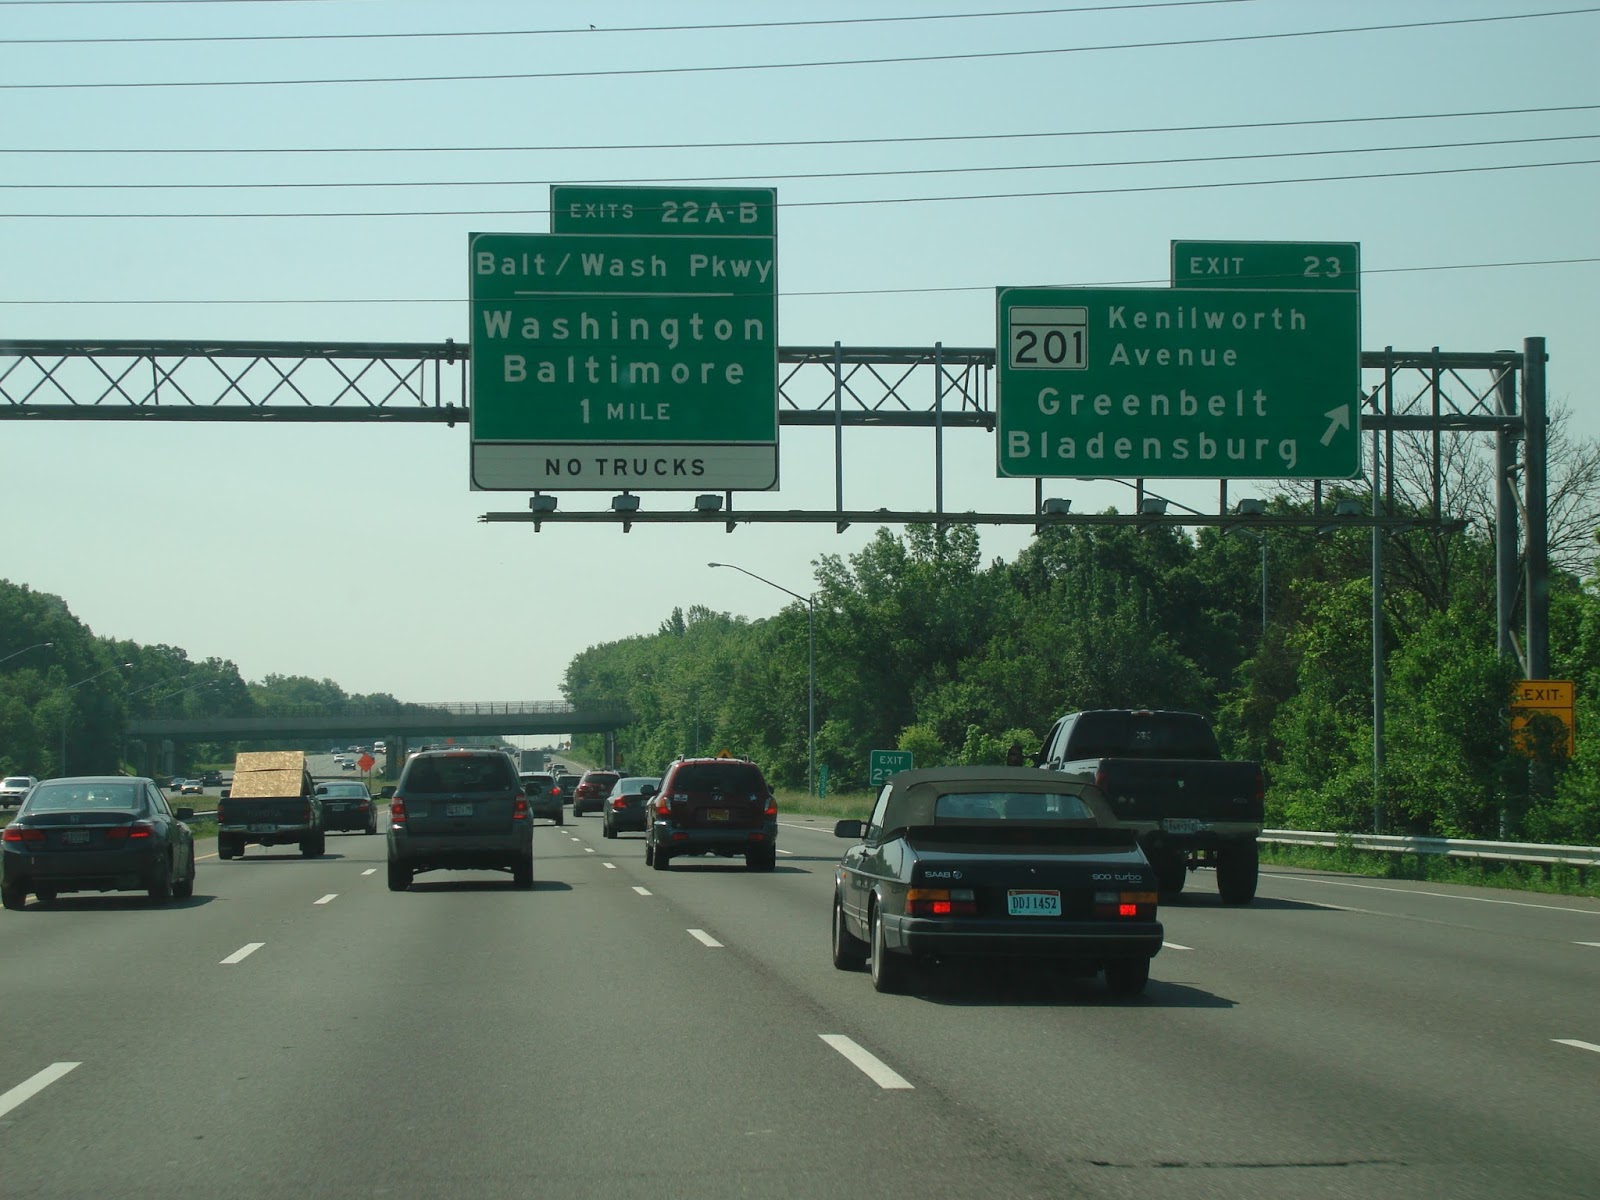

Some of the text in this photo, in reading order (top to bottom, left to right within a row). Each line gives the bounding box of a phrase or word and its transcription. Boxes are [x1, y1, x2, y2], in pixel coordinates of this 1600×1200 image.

[570, 201, 758, 224] EXITS 22A-B
[690, 254, 772, 283] Pkwy
[1190, 256, 1342, 278] EXIT 23
[1109, 305, 1306, 330] Kenilworth
[483, 310, 763, 350] Washington
[1015, 330, 1082, 364] 201
[1109, 343, 1238, 366] Avenue
[504, 355, 744, 384] Baltimore
[580, 398, 670, 424] 1 MILE
[1038, 387, 1267, 417] Greenbelt
[1008, 430, 1297, 470] Bladensburg
[545, 458, 706, 477] NO TRUCKS
[1524, 688, 1560, 701] EXIT
[879, 755, 904, 765] EXIT
[1114, 872, 1142, 881] turbo
[1012, 896, 1057, 909] DDJ 1452
